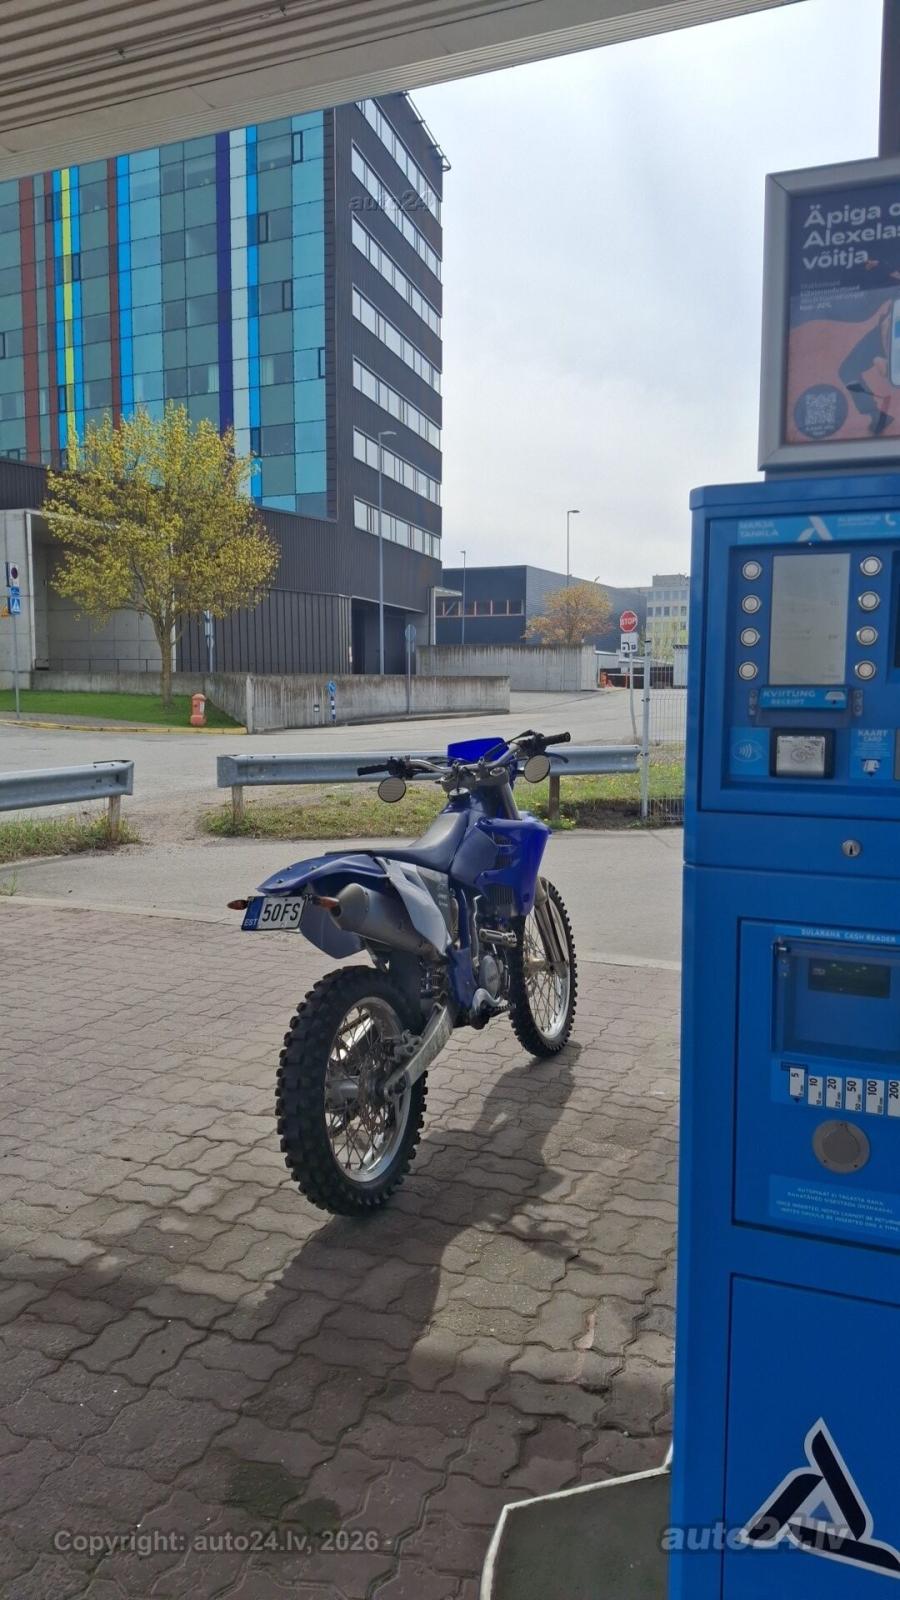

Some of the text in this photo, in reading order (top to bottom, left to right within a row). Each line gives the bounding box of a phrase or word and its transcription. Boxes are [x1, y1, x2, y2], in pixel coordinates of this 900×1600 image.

[803, 204, 881, 229] Äpiga
[802, 222, 900, 249] Alexela
[802, 247, 868, 270] võitja
[620, 616, 637, 626] STOP
[262, 902, 301, 922] 50FS
[244, 918, 258, 926] EST
[809, 1078, 818, 1086] 10
[827, 1078, 837, 1090] 20
[847, 1080, 857, 1092] 50
[867, 1080, 877, 1096] 100
[889, 1081, 899, 1099] 200
